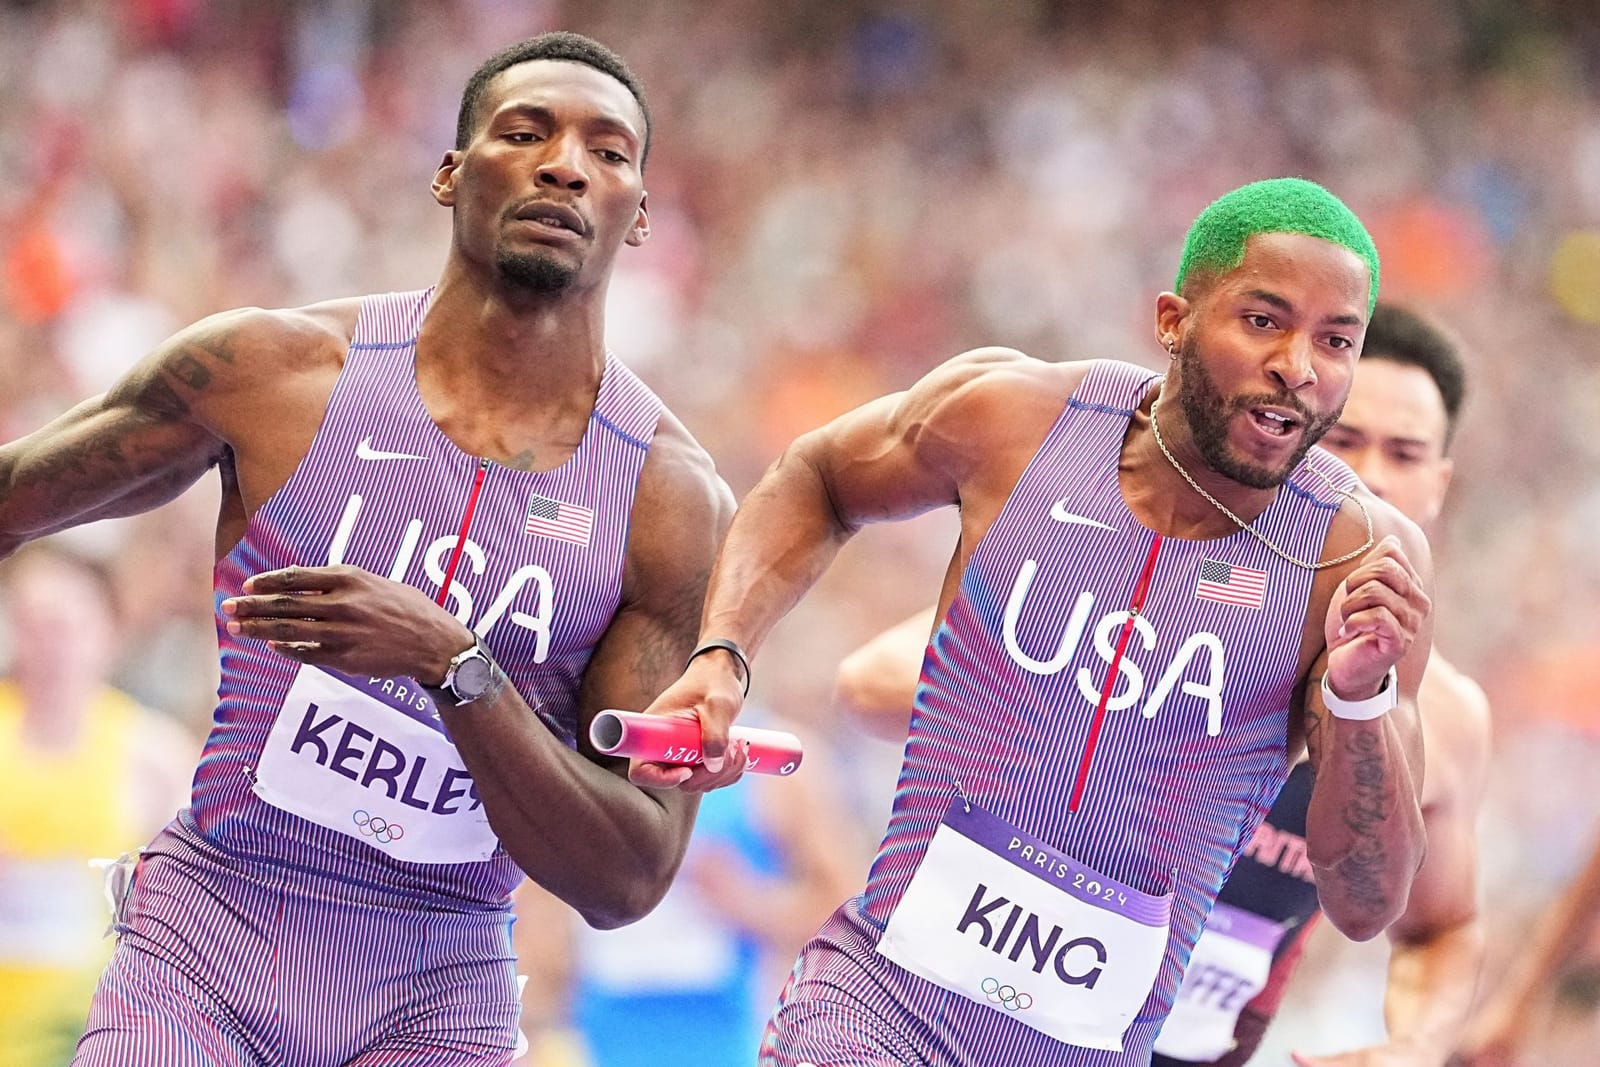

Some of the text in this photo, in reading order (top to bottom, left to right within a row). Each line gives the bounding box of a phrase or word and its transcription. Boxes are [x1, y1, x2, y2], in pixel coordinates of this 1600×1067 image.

[328, 494, 554, 664] USA
[1002, 559, 1225, 737] USA
[956, 883, 1107, 990] KING
[1008, 836, 1128, 906] PARIS 2024
